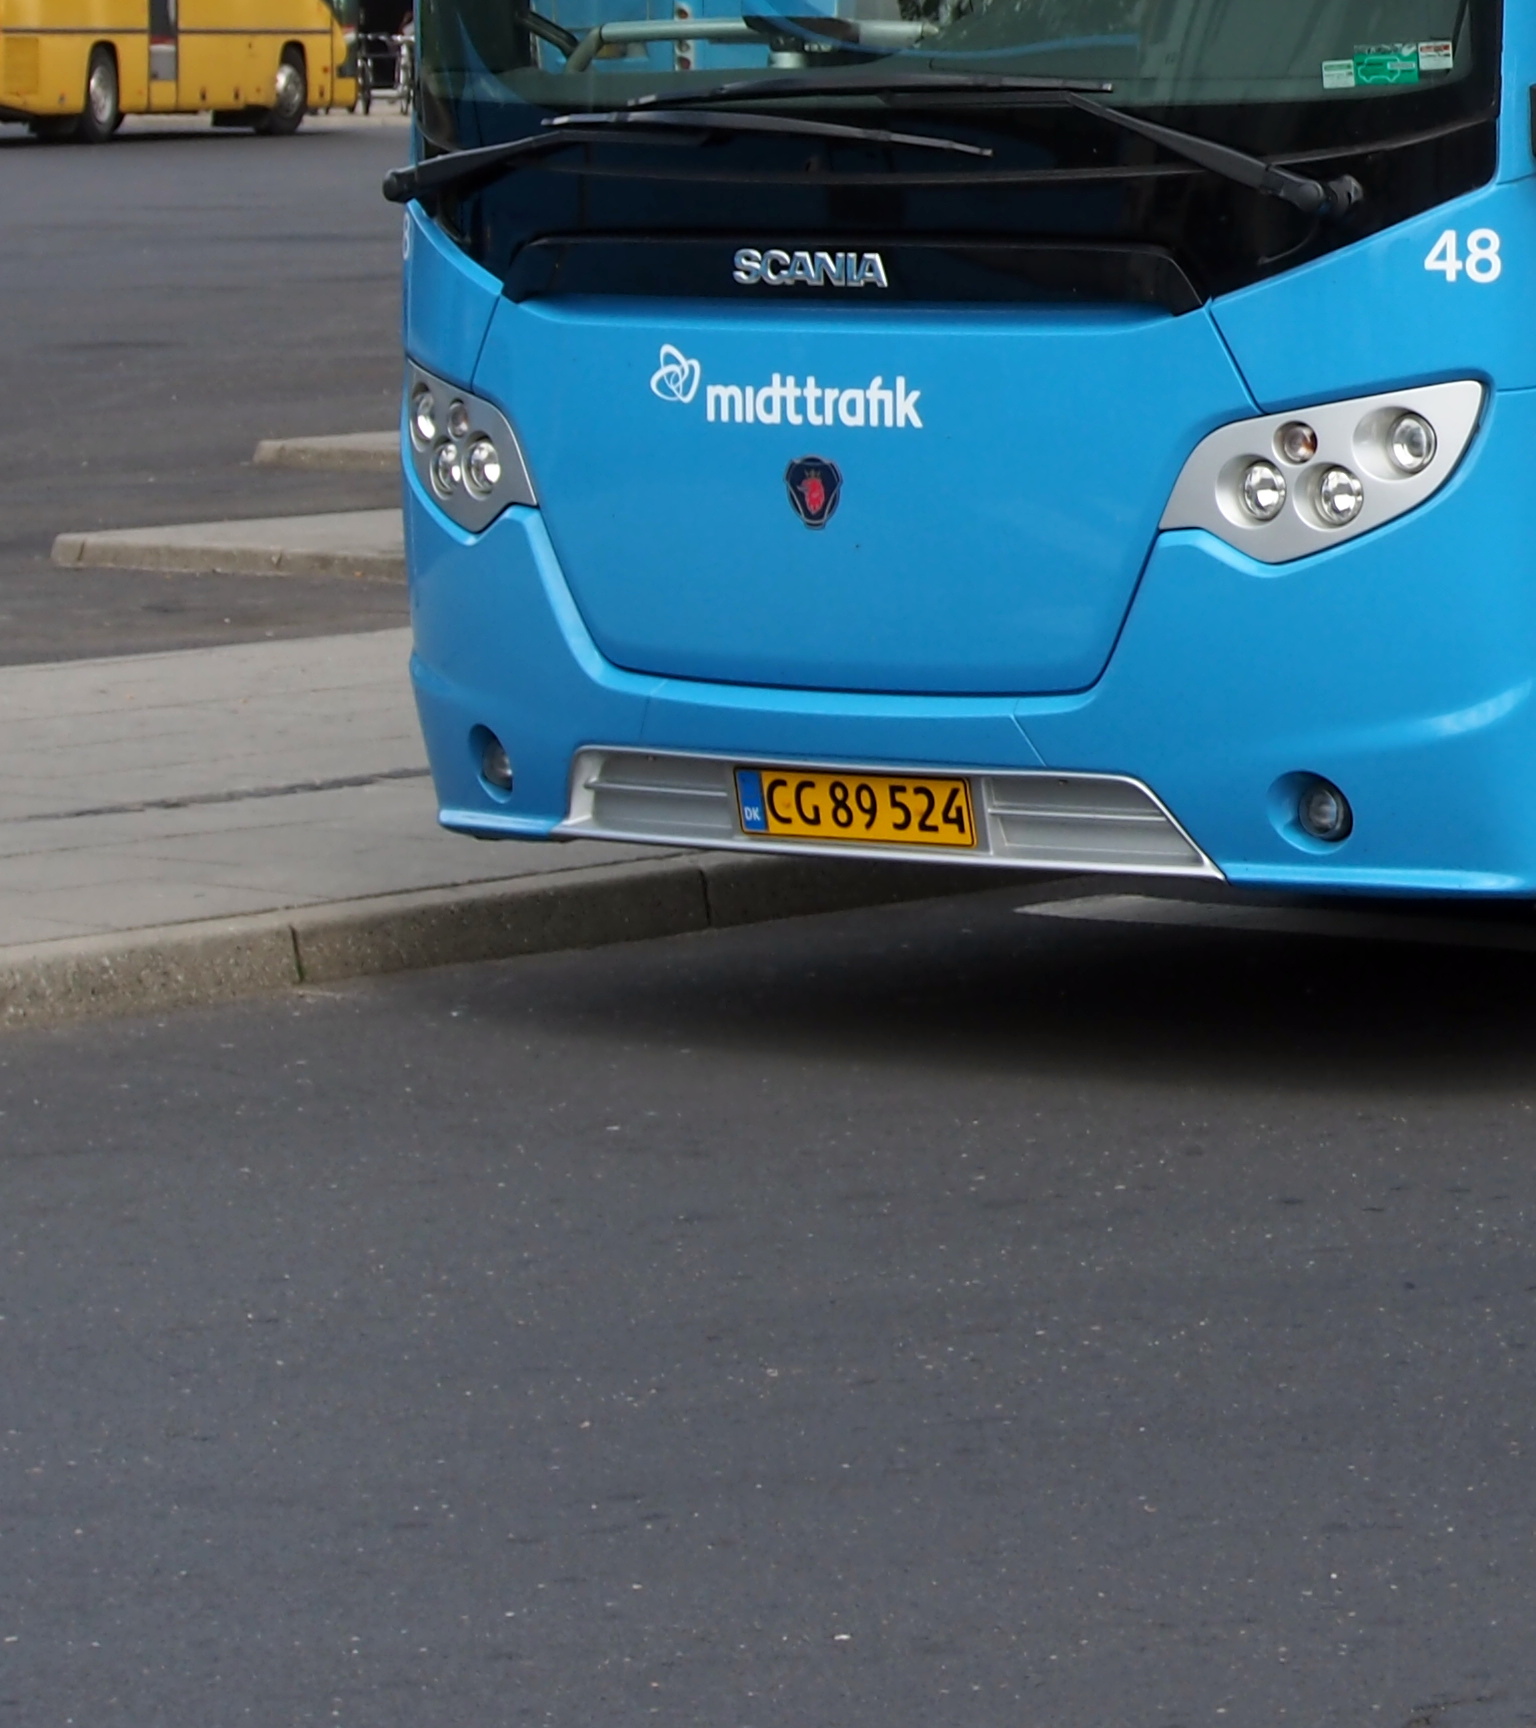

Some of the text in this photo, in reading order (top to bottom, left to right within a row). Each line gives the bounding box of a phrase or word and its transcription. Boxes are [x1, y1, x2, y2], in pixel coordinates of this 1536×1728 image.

[733, 248, 888, 287] SCANIA
[1424, 228, 1501, 283] 48
[706, 373, 923, 428] midttrafik
[744, 805, 762, 822] DK
